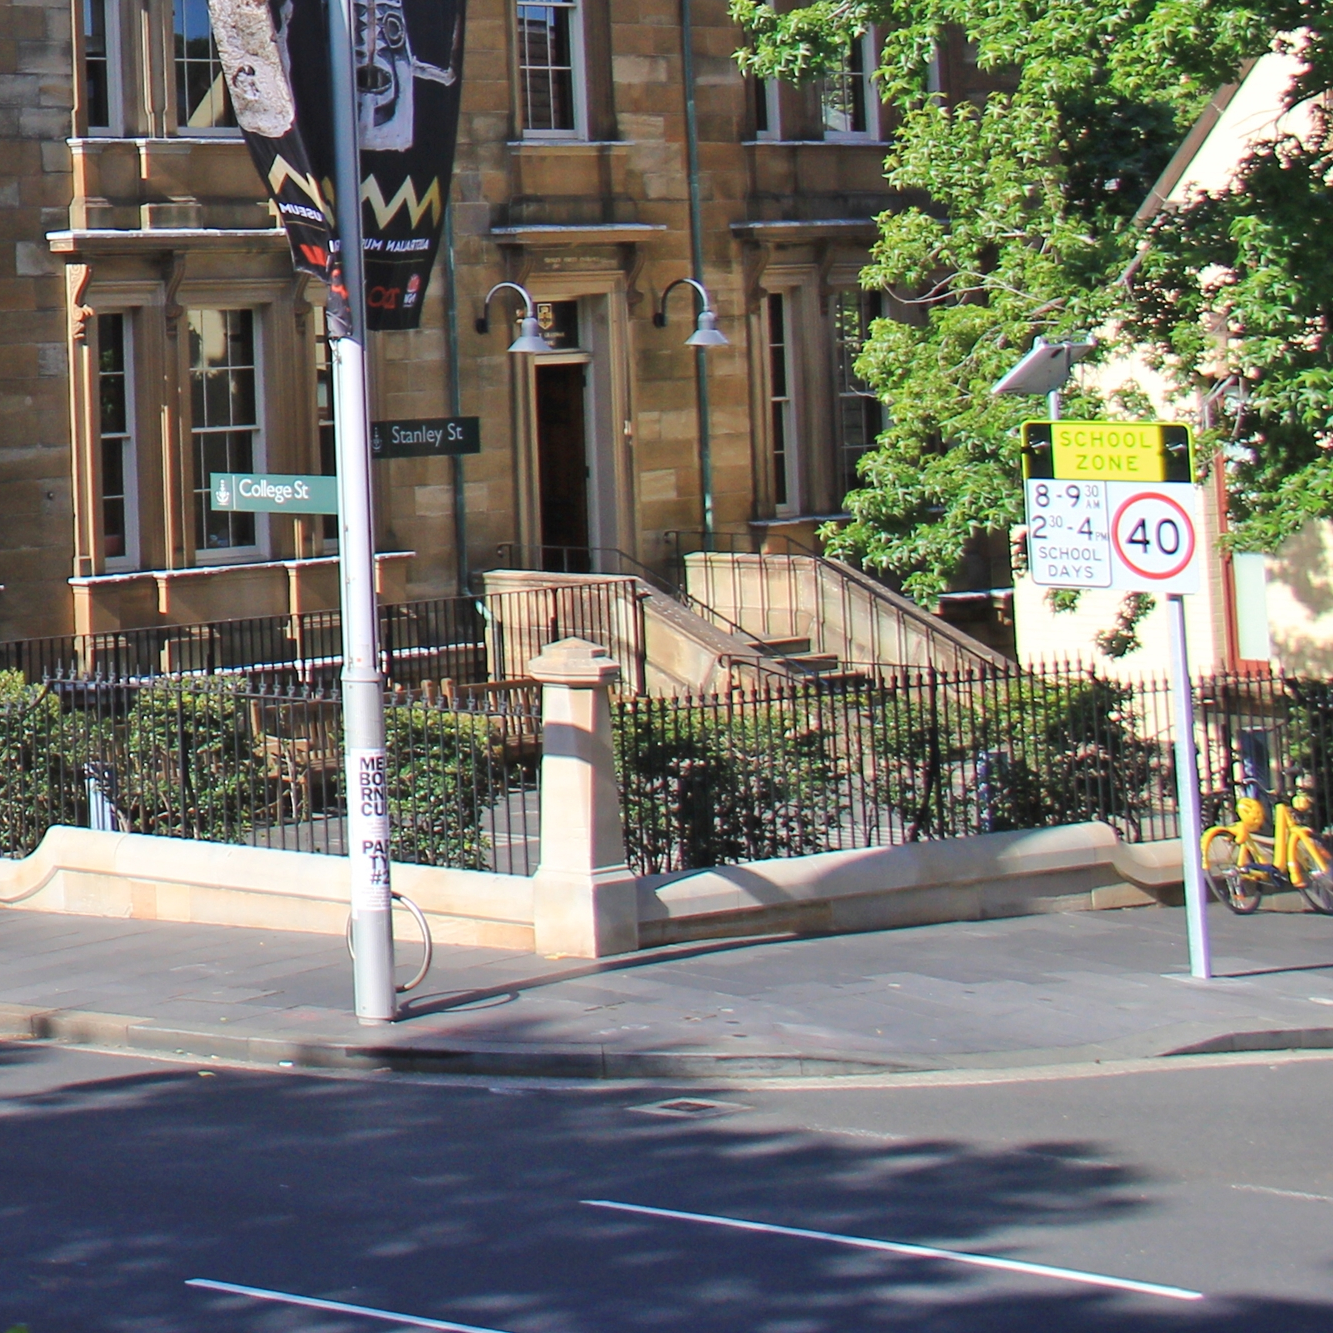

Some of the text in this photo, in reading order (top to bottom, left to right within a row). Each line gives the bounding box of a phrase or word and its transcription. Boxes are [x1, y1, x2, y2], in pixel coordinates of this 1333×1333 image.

[392, 423, 463, 447] Stanley St
[1060, 431, 1152, 449] SCHOOL
[1076, 454, 1139, 472] ZONE
[239, 478, 309, 503] College St
[1126, 517, 1180, 555] 40
[1038, 546, 1102, 561] SCHOOL
[1048, 564, 1094, 579] DAYS
